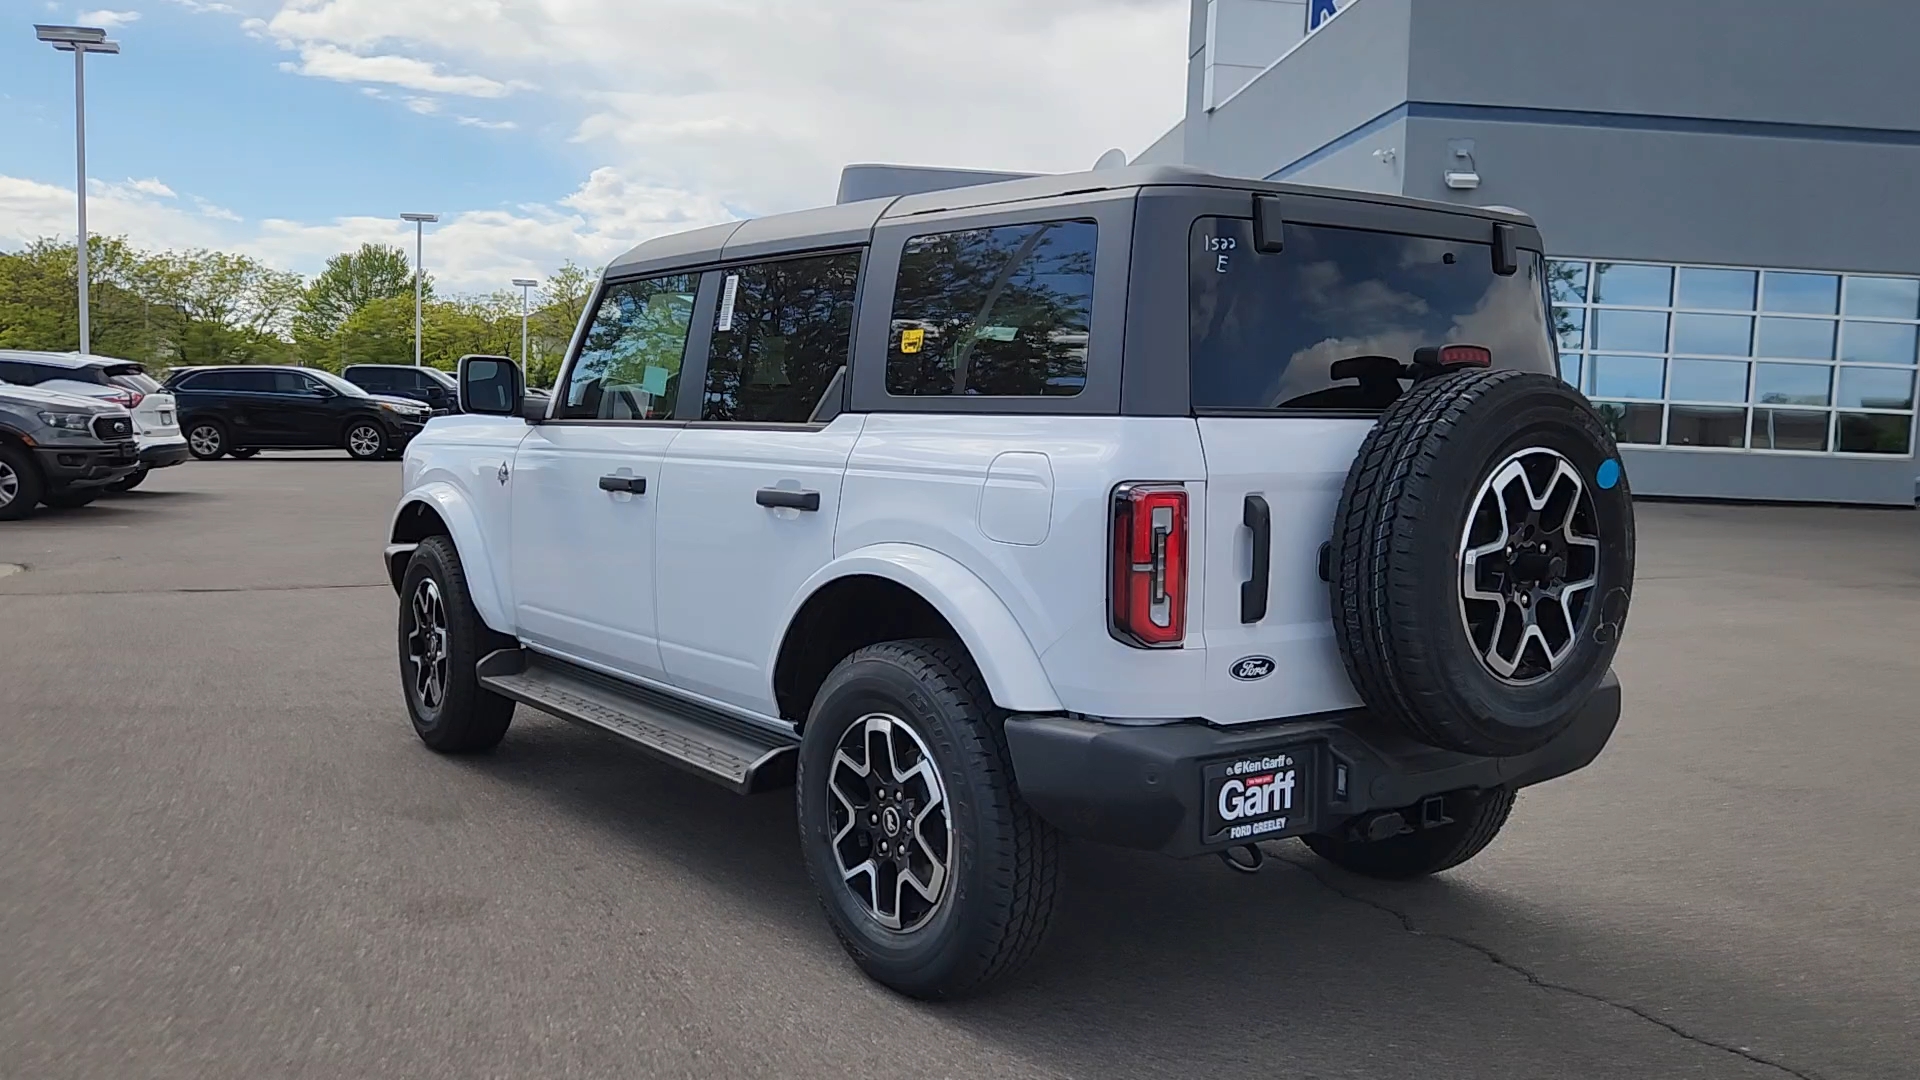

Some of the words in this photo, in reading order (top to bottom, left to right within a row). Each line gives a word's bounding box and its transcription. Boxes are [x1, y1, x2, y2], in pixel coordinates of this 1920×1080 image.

[1216, 254, 1229, 273] E
[1239, 660, 1270, 677] Ford
[1242, 760, 1261, 774] Ken
[1262, 754, 1286, 770] Garff
[1218, 769, 1295, 821] Garff
[1230, 824, 1252, 839] FORD
[1252, 817, 1287, 834] GREELEY
